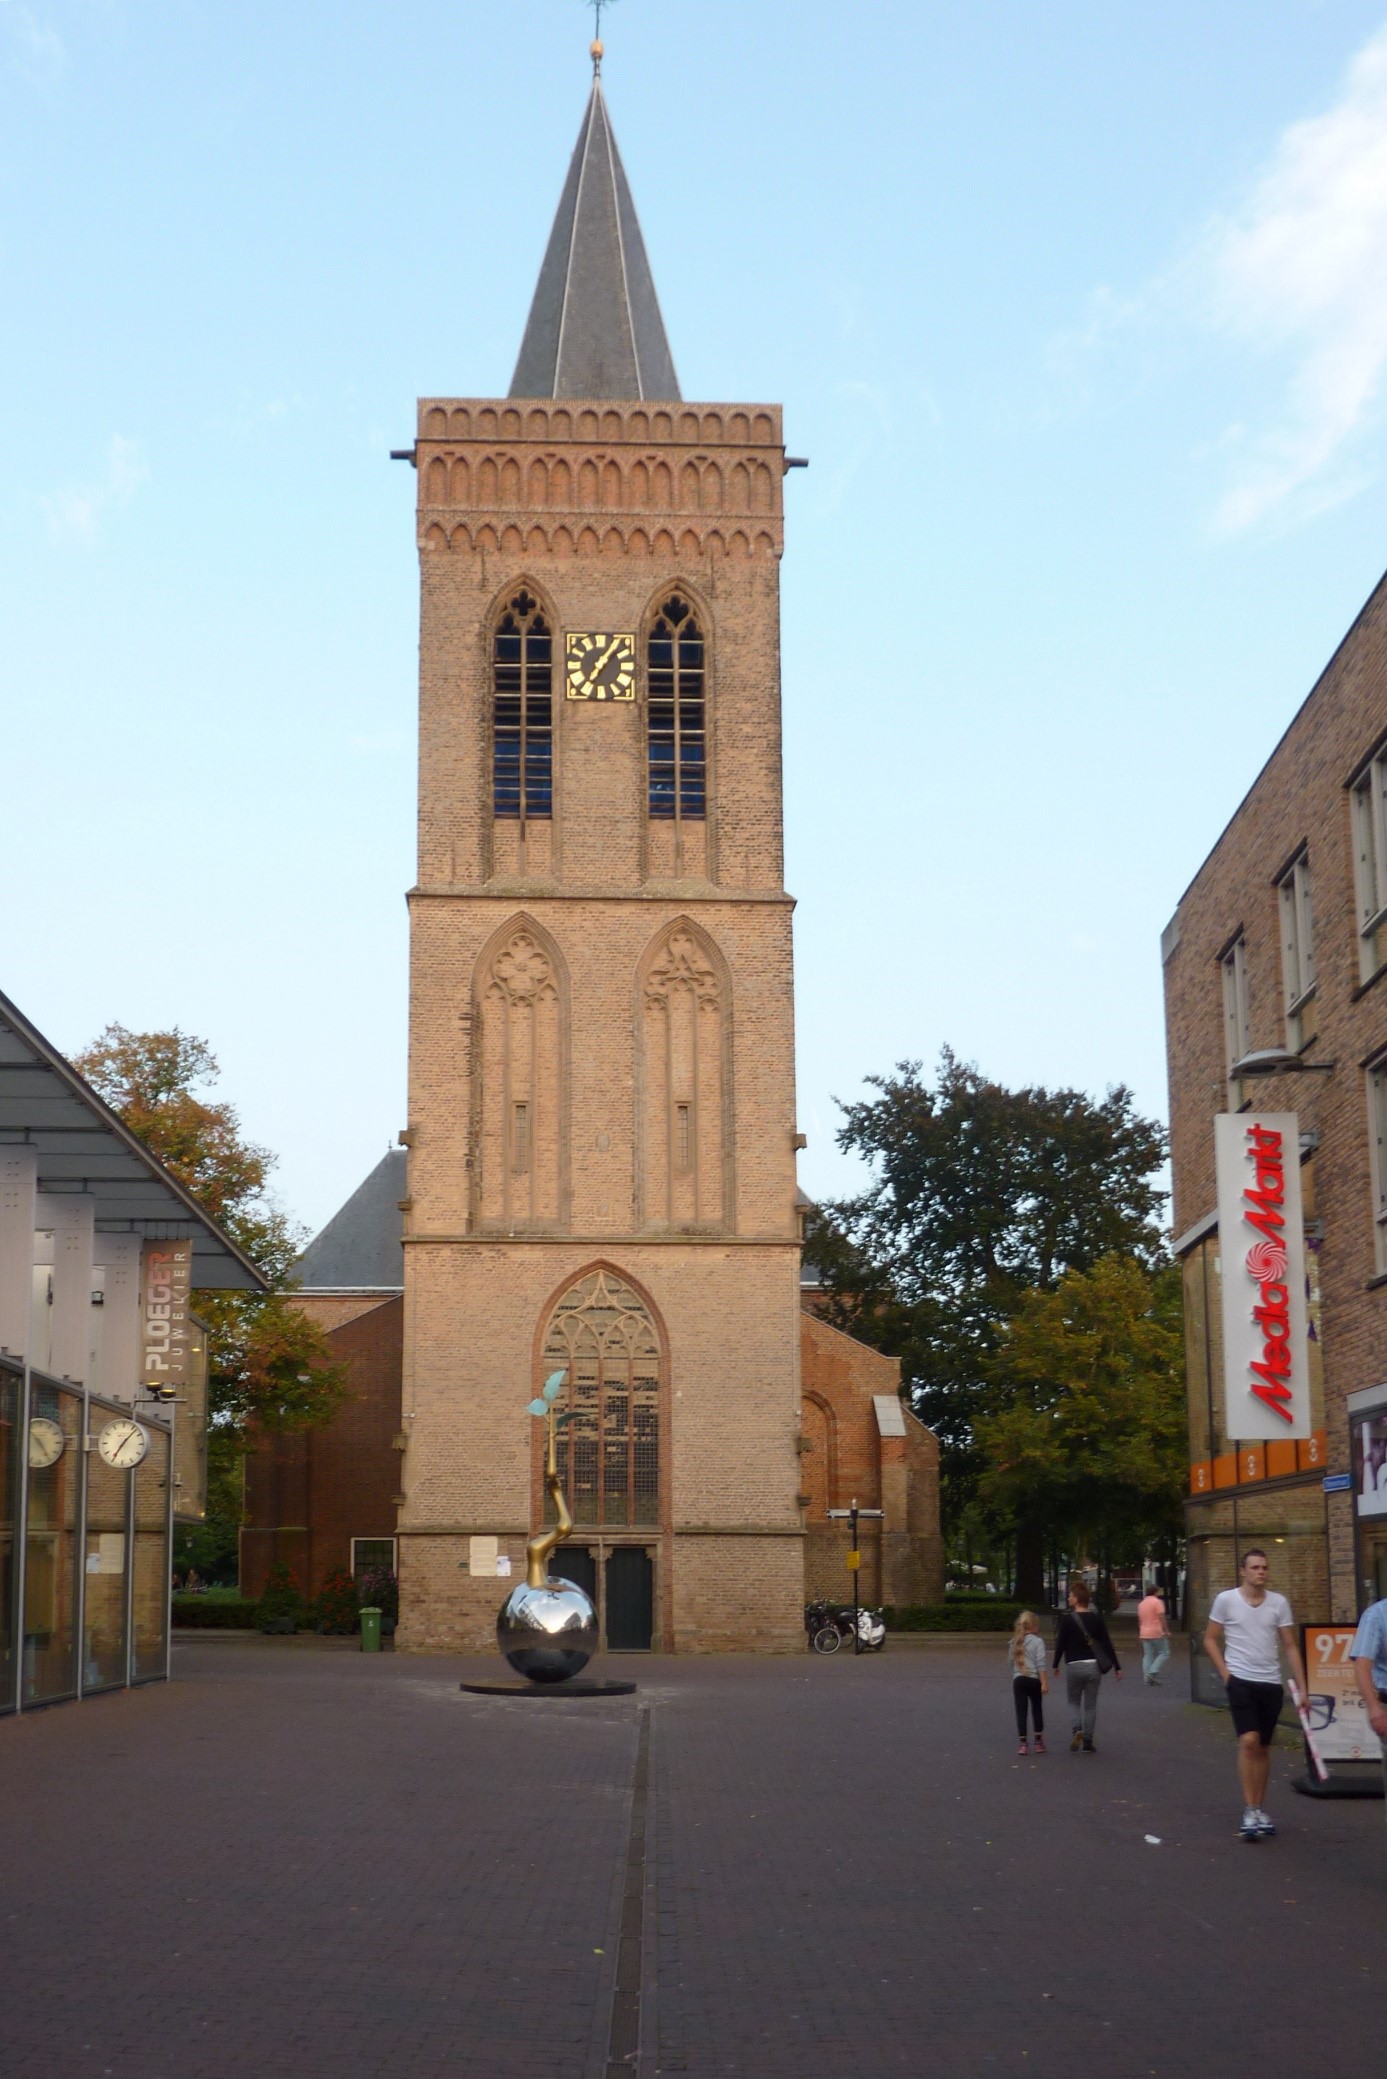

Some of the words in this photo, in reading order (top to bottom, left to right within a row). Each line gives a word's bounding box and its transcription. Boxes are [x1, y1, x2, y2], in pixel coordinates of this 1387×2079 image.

[1243, 1123, 1286, 1249] Markt
[145, 1252, 172, 1370] PLOEGER
[171, 1253, 186, 1371] JUWELIER
[1249, 1281, 1293, 1424] Media
[1315, 1634, 1354, 1662] 97
